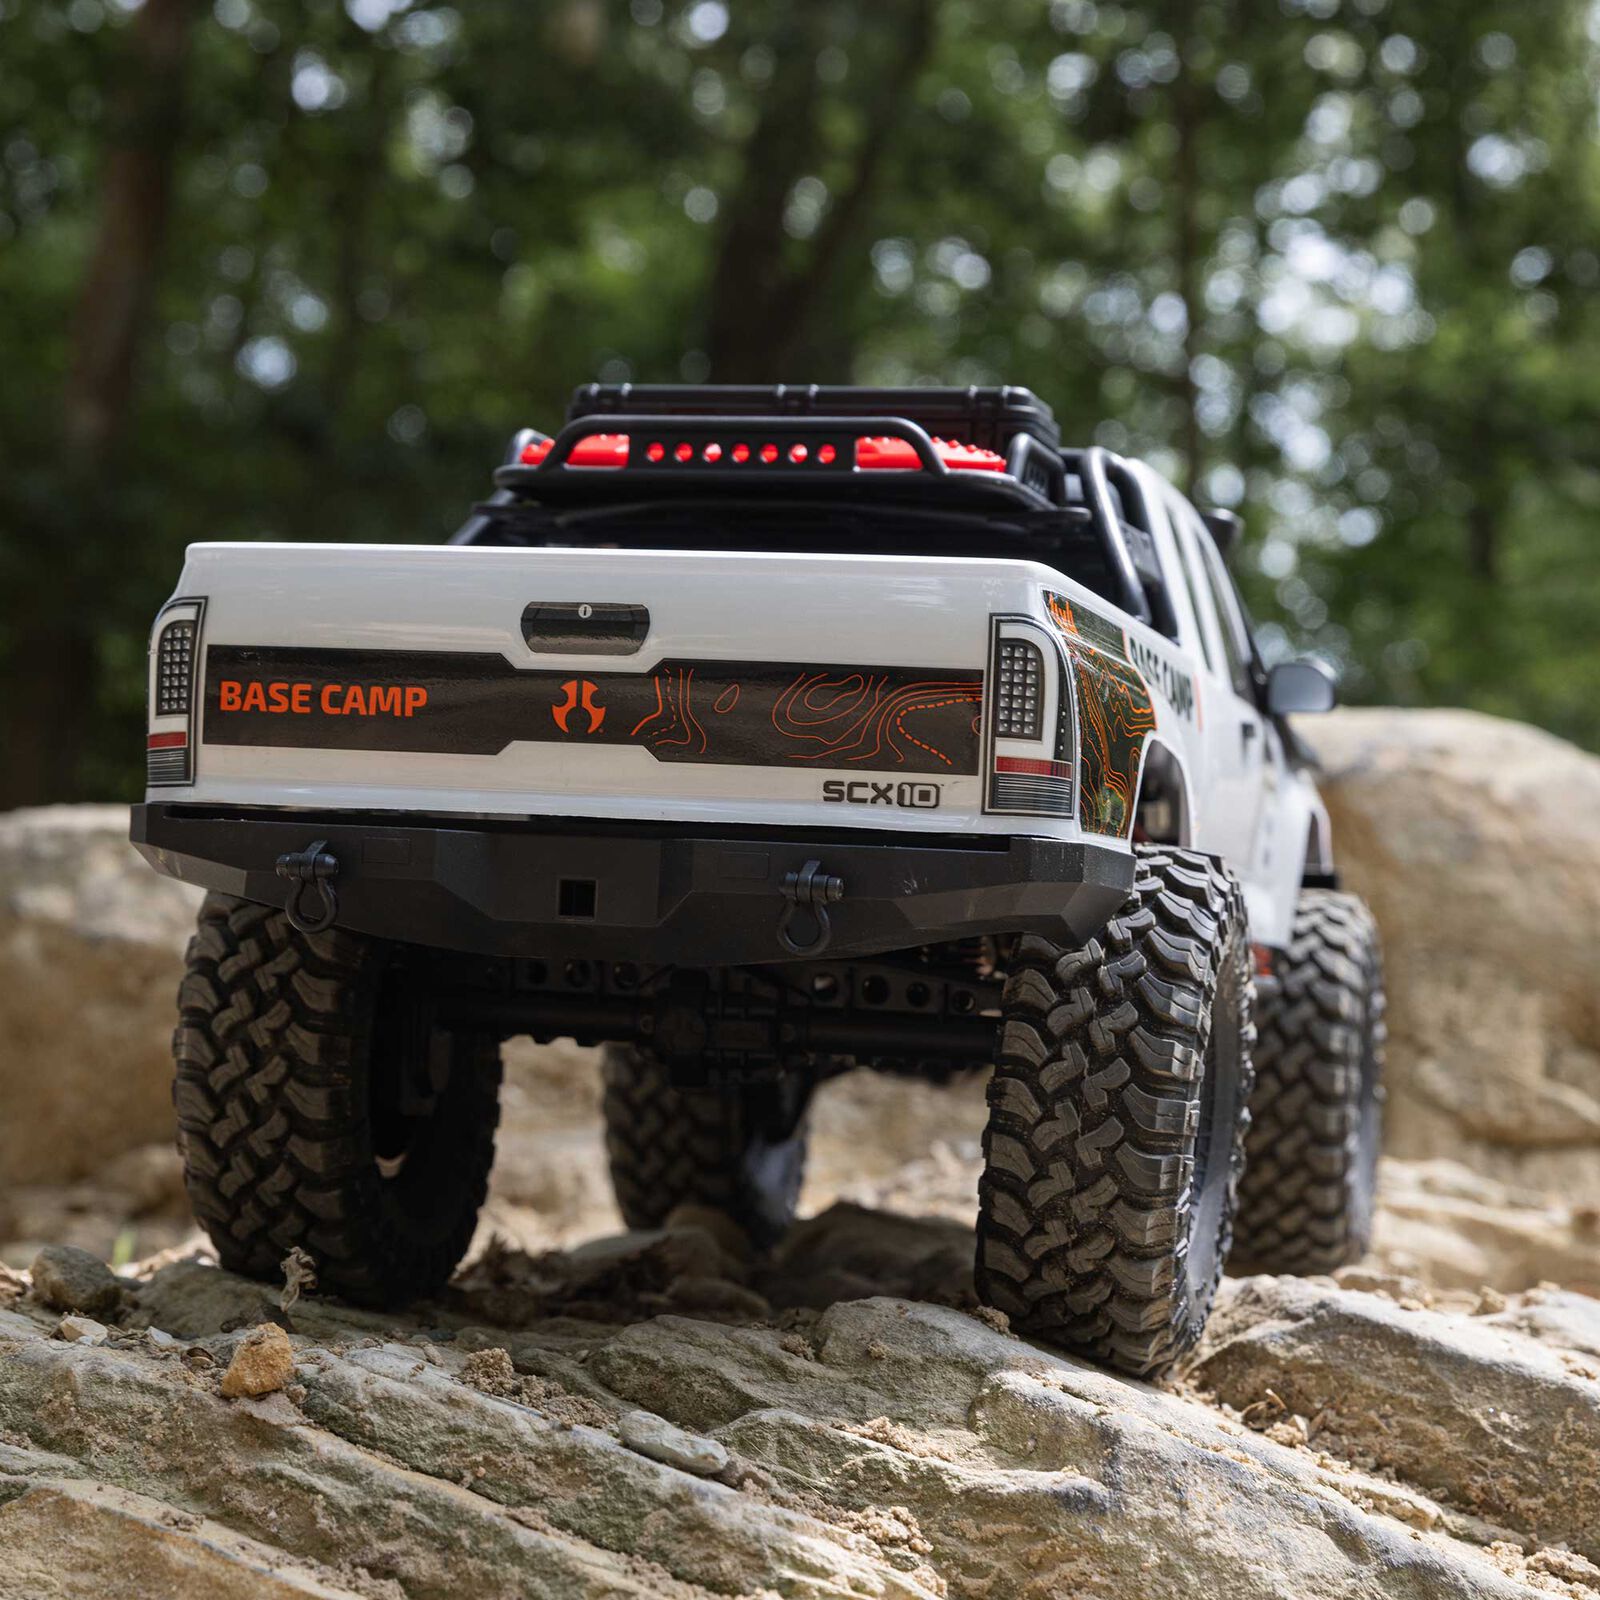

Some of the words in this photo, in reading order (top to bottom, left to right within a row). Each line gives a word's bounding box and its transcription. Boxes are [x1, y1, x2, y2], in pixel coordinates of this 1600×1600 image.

[219, 681, 312, 713] BASE
[321, 684, 428, 717] CAMP
[823, 780, 940, 808] SCX10
